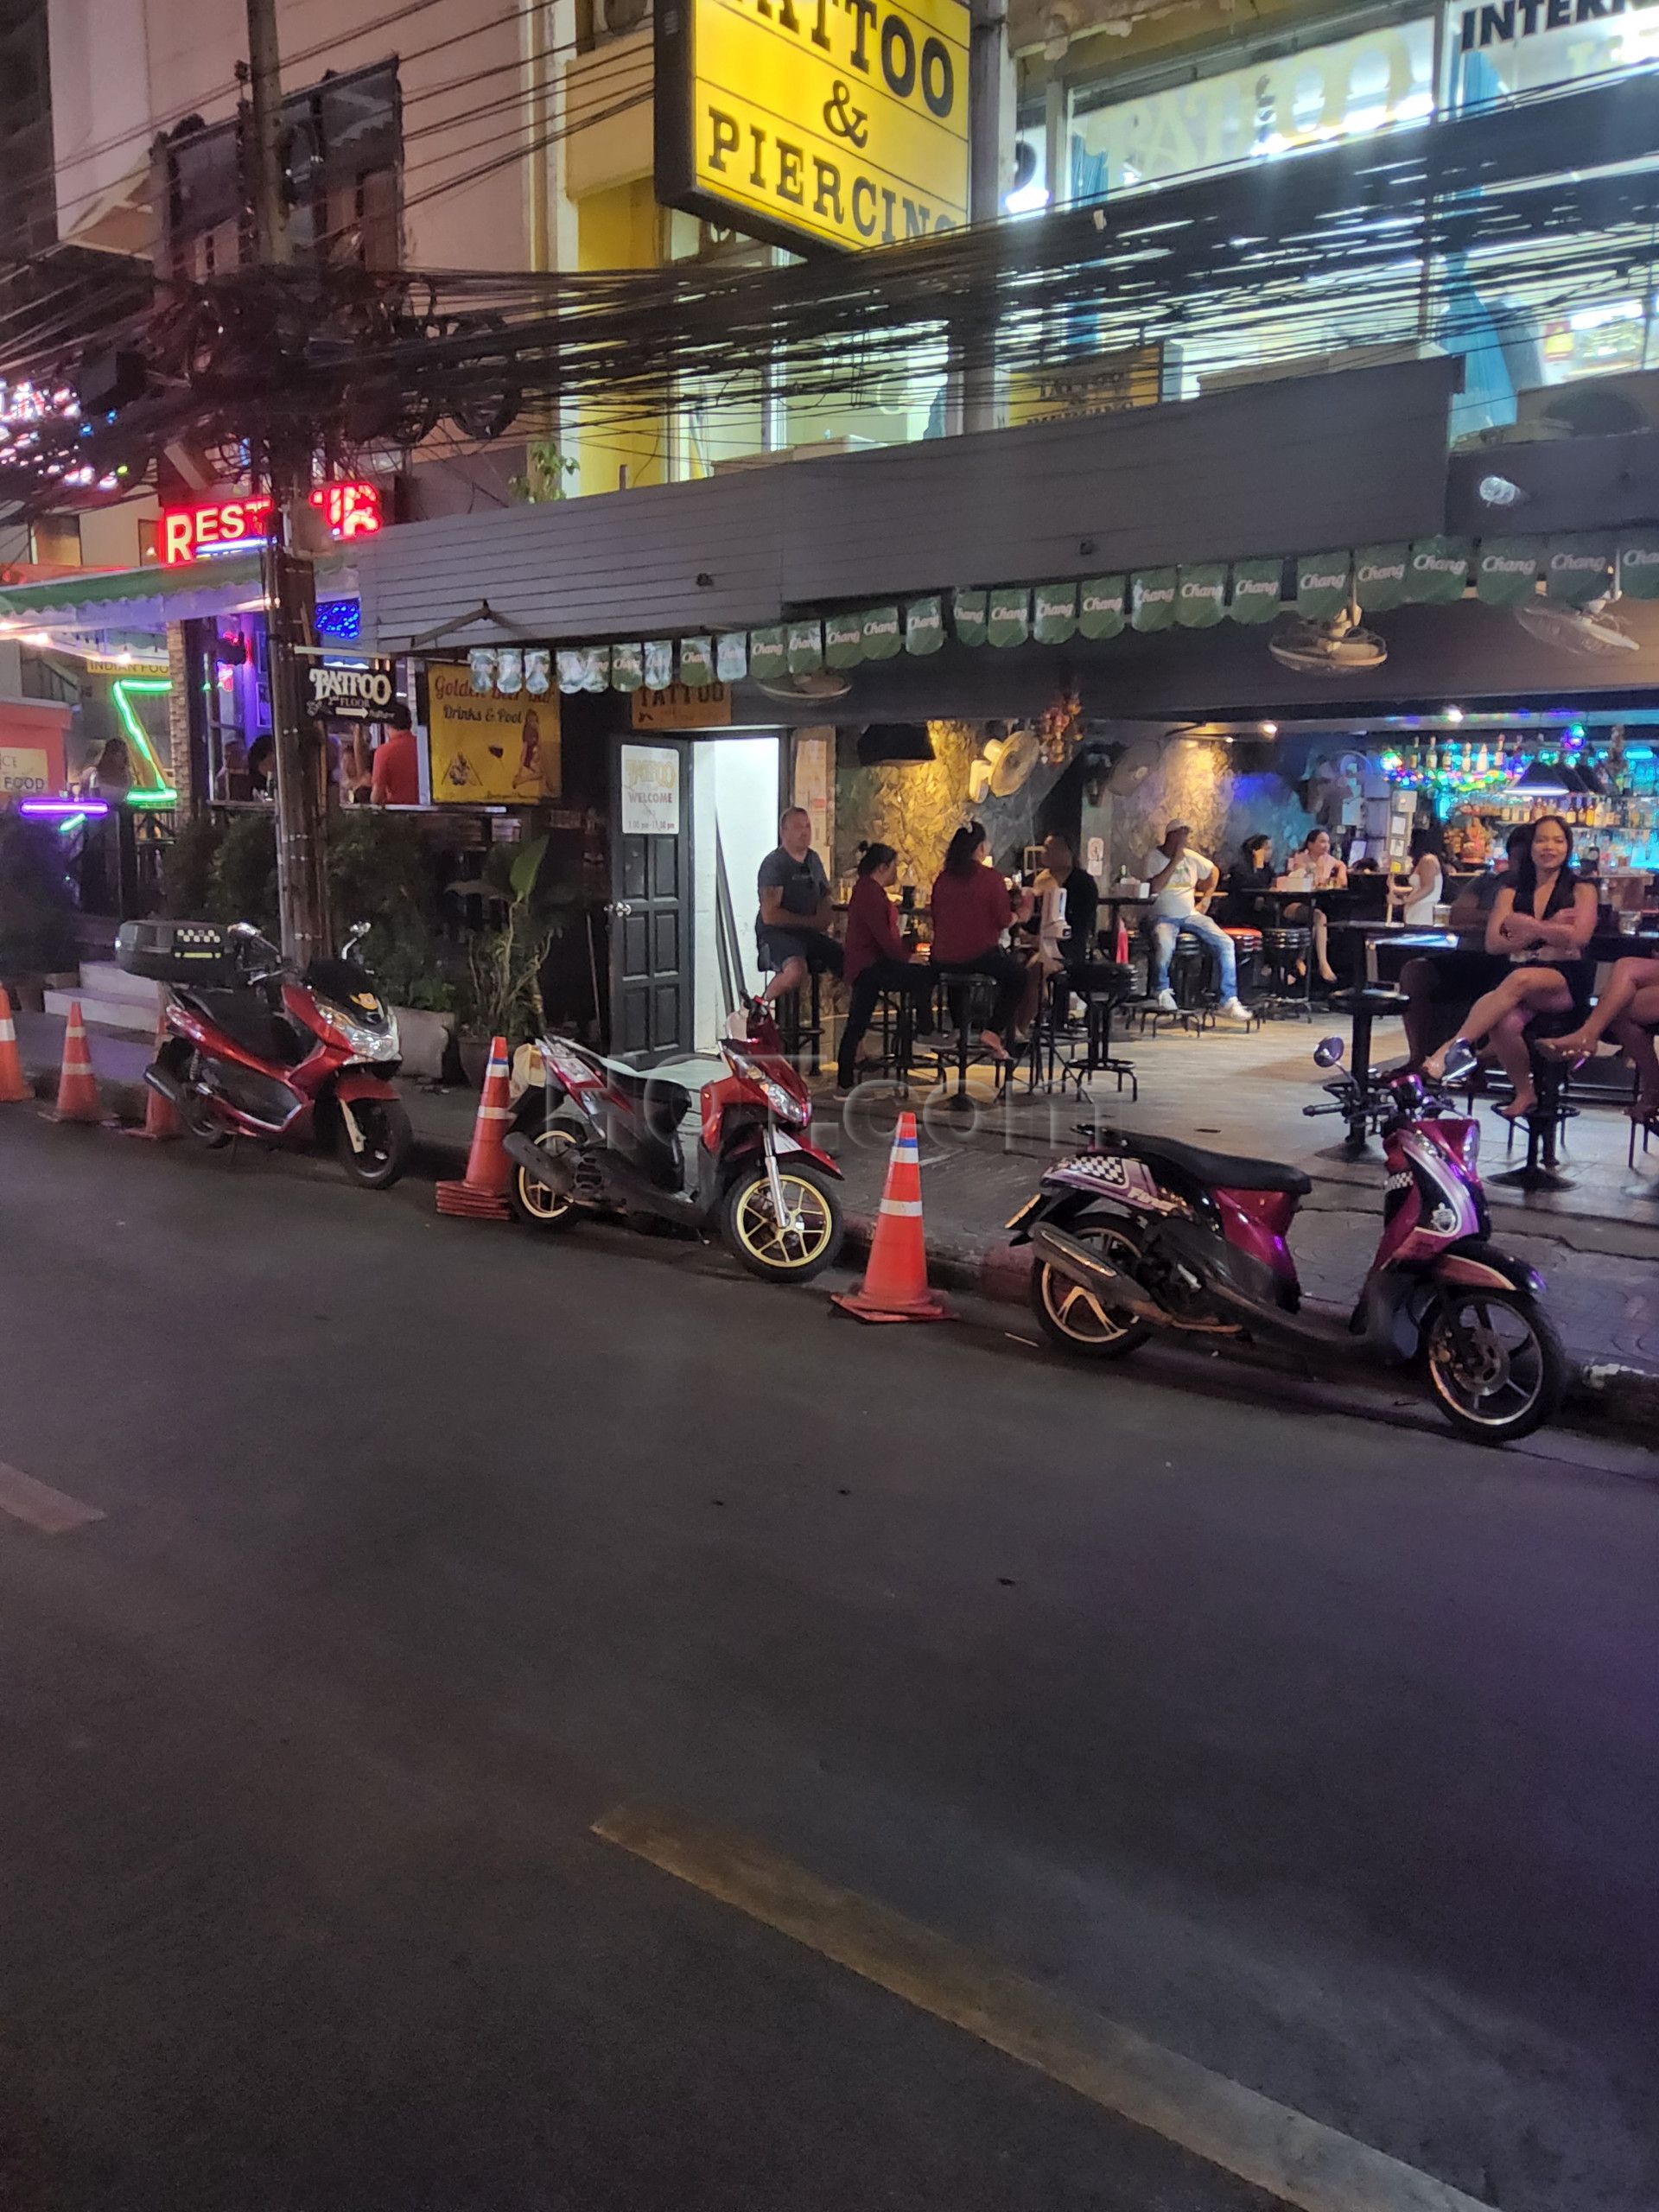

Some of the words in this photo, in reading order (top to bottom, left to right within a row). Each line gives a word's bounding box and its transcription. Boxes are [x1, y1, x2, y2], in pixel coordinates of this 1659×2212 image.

[739, 0, 954, 118] TTOO
[823, 79, 868, 149] &
[1414, 554, 1467, 575] Chang
[1482, 556, 1536, 575] Chang
[1551, 554, 1606, 571] Chang
[1357, 564, 1405, 582] Chang
[1236, 580, 1279, 596] Chang
[1300, 574, 1345, 589] Chang
[1134, 588, 1174, 603] hang
[1181, 583, 1224, 603] Chang
[1083, 597, 1122, 612] Chang
[991, 607, 1027, 622] Chang
[864, 622, 897, 636] Chang
[909, 616, 939, 630] Chang
[827, 631, 860, 645] Chang
[753, 643, 783, 656] Chang
[141, 664, 168, 674] FOO
[309, 668, 392, 706] TATTOO
[443, 705, 481, 721] Drinks
[485, 709, 494, 722] &
[4, 777, 44, 789] FOOD
[628, 792, 672, 804] WELCOME
